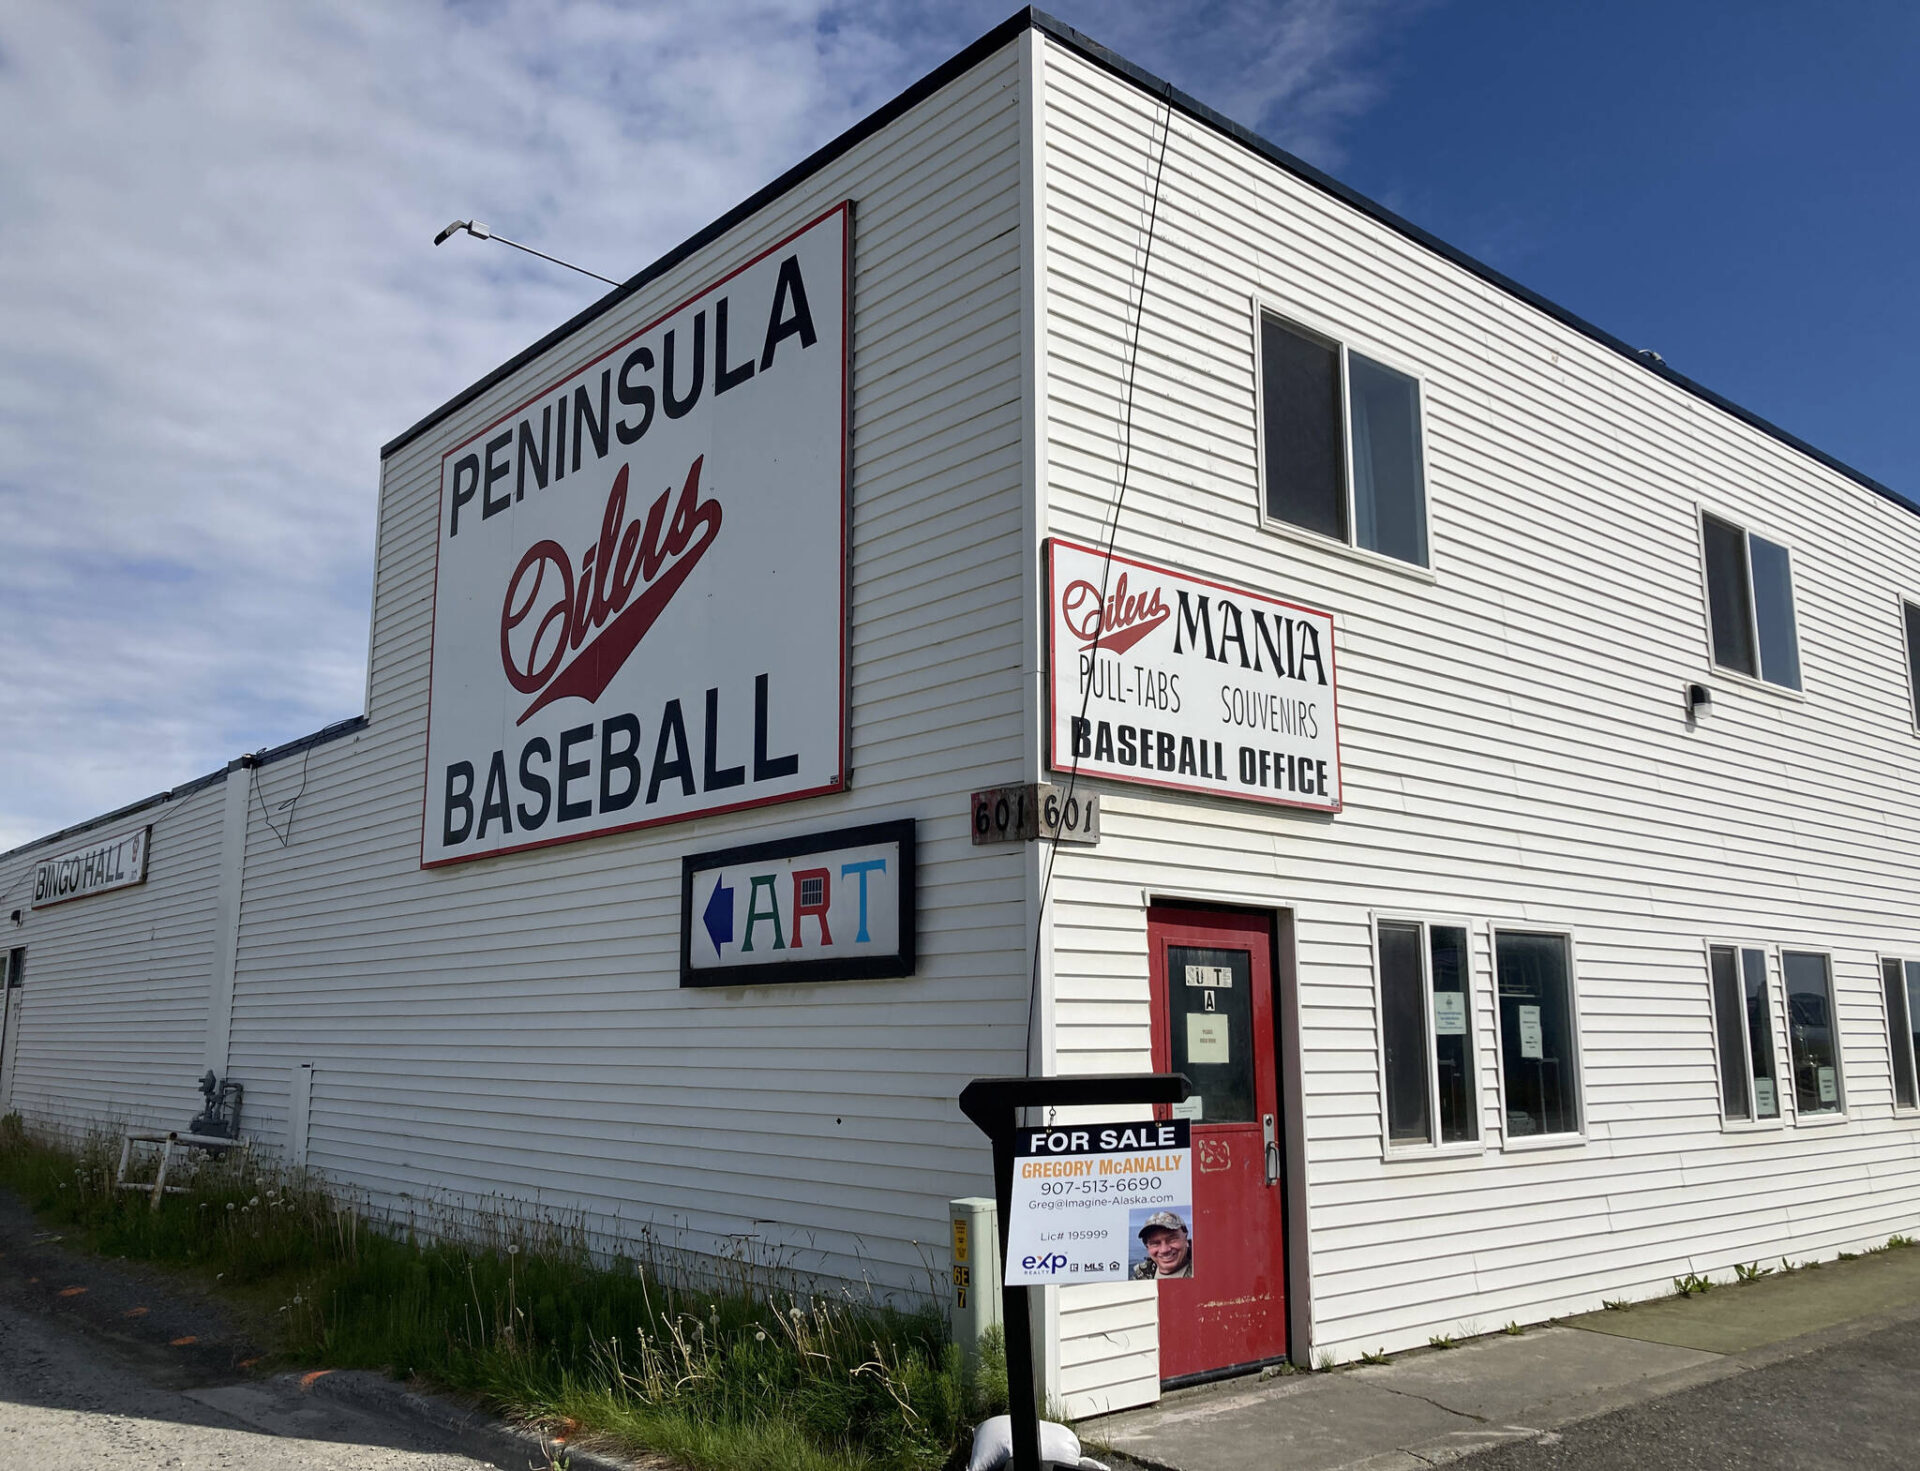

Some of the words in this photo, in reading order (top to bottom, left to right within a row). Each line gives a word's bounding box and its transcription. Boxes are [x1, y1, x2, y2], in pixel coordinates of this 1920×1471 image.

[450, 254, 817, 537] PENINSULA
[500, 454, 722, 696] Oilers
[1062, 572, 1170, 642] Oilers
[1173, 590, 1328, 686] MANIA
[1079, 654, 1181, 713] PULL-TABS
[1221, 685, 1318, 740] SOUVENIRS
[443, 672, 798, 847] BASEBALL
[1071, 715, 1227, 781] BASEBALL
[1238, 746, 1328, 797] OFFICE
[975, 794, 1024, 834] 601
[1044, 794, 1092, 833] 601
[35, 855, 80, 901] BINGO
[82, 842, 124, 889] HALL
[741, 858, 886, 952] ART
[1187, 967, 1231, 986] SUTE
[1206, 991, 1214, 1010] A
[1030, 1131, 1090, 1153] FOR
[1099, 1126, 1176, 1149] SALE
[1022, 1160, 1094, 1179] GREGORY
[1100, 1155, 1182, 1176] McANALLY
[1028, 1194, 1174, 1210] Greg@Imagine-Alaska.com
[1041, 1176, 1162, 1195] 907-513-6690
[1040, 1232, 1064, 1241] Lic#
[1068, 1230, 1108, 1240] 195999
[953, 1266, 969, 1287] 6E
[1084, 1262, 1104, 1272] MLS
[958, 1289, 966, 1309] 7
